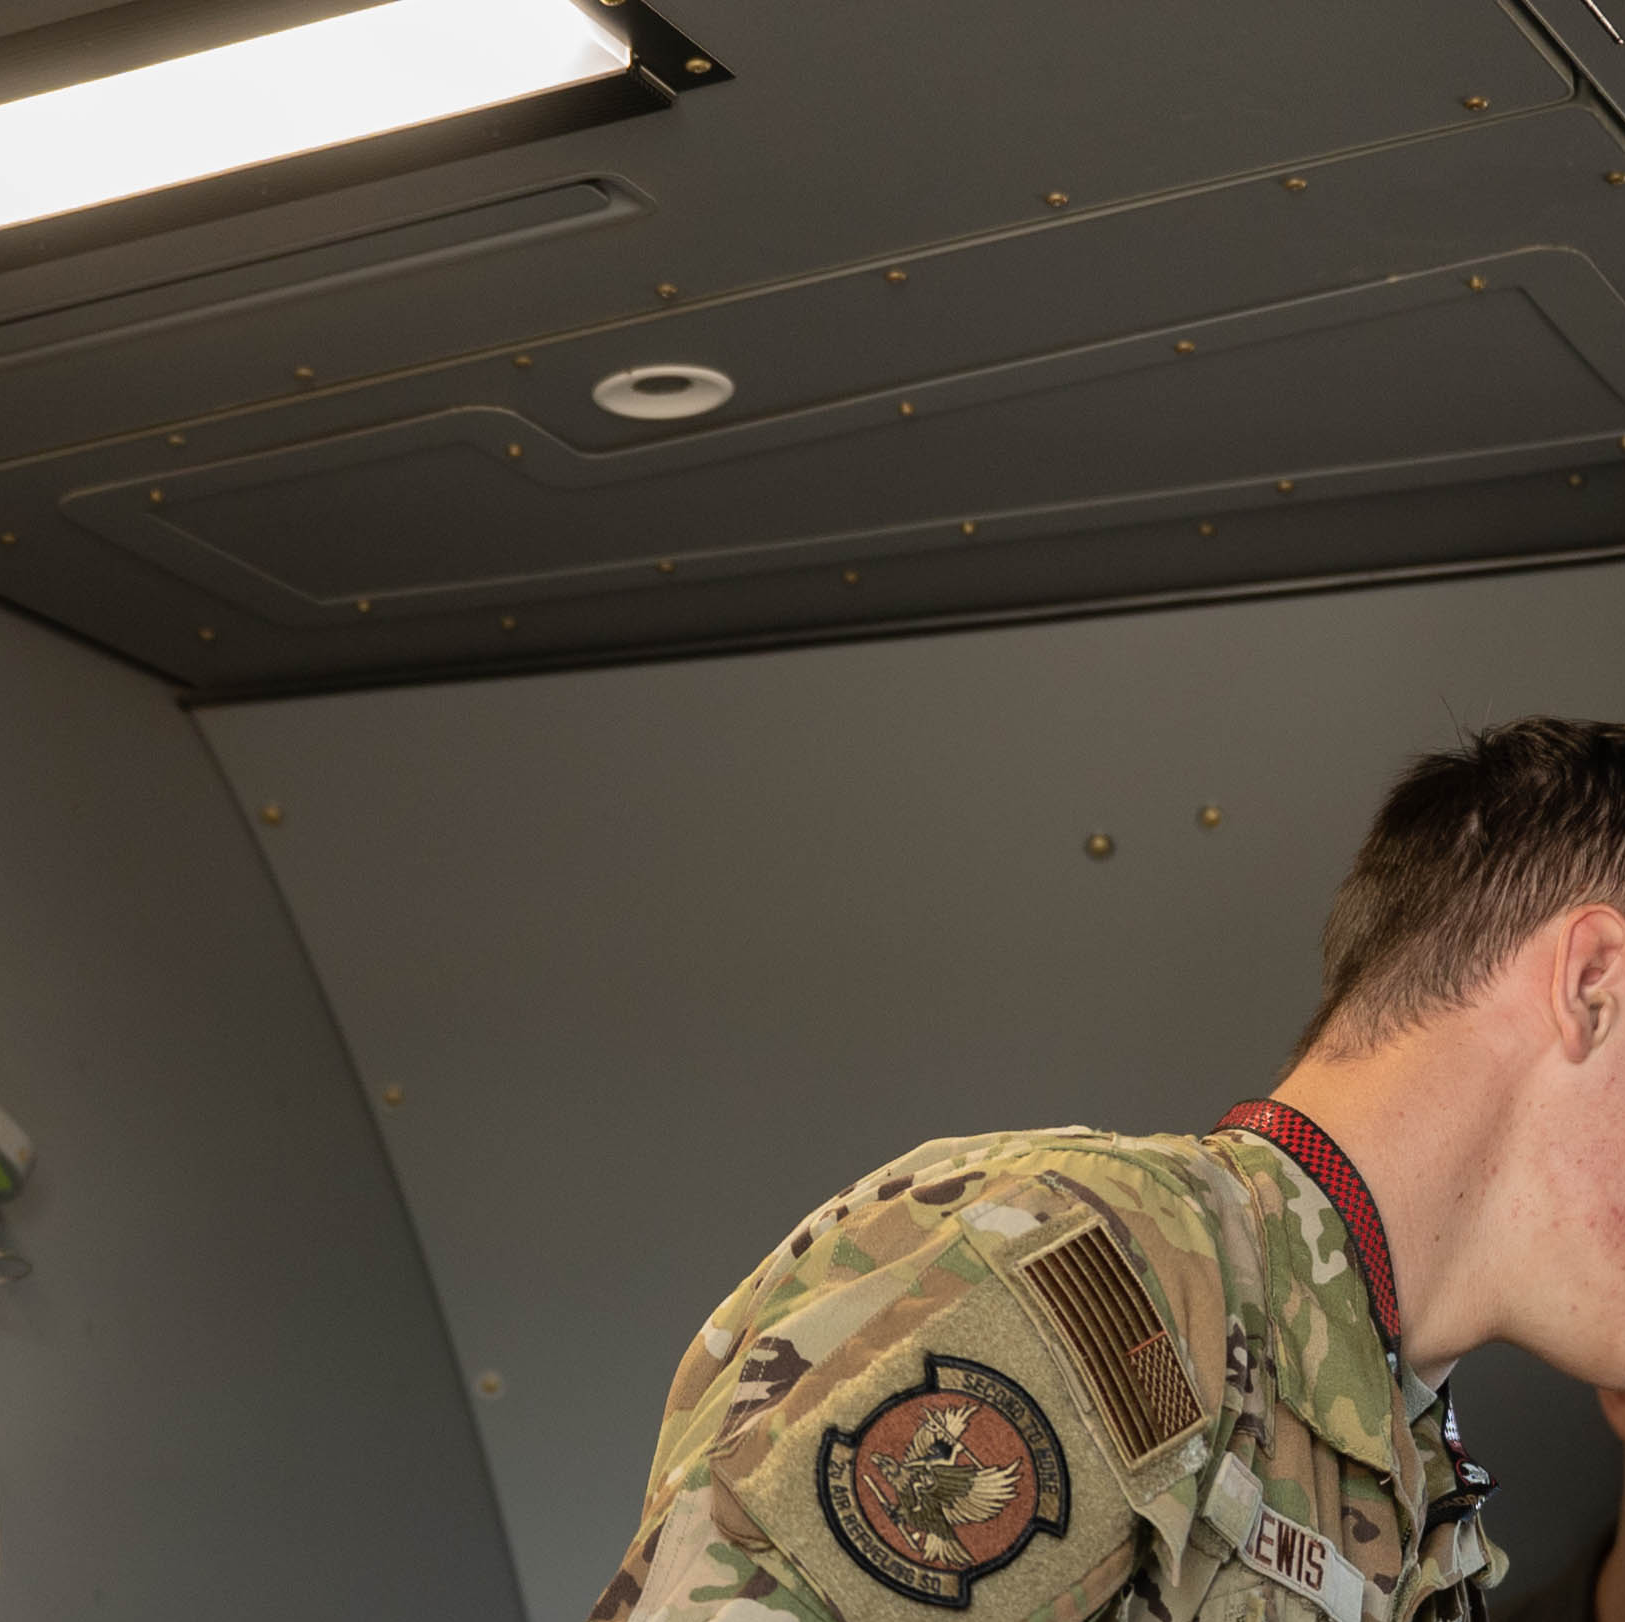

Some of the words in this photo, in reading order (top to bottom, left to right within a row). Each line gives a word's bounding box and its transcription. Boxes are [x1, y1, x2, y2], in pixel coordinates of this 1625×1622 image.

[963, 1373, 1025, 1420] SECOND
[1024, 1419, 1044, 1444] TO
[1036, 1448, 1059, 1495] NONE
[832, 1485, 852, 1510] AIR
[842, 1513, 916, 1584] REFUELING
[919, 1574, 942, 1594] SQ
